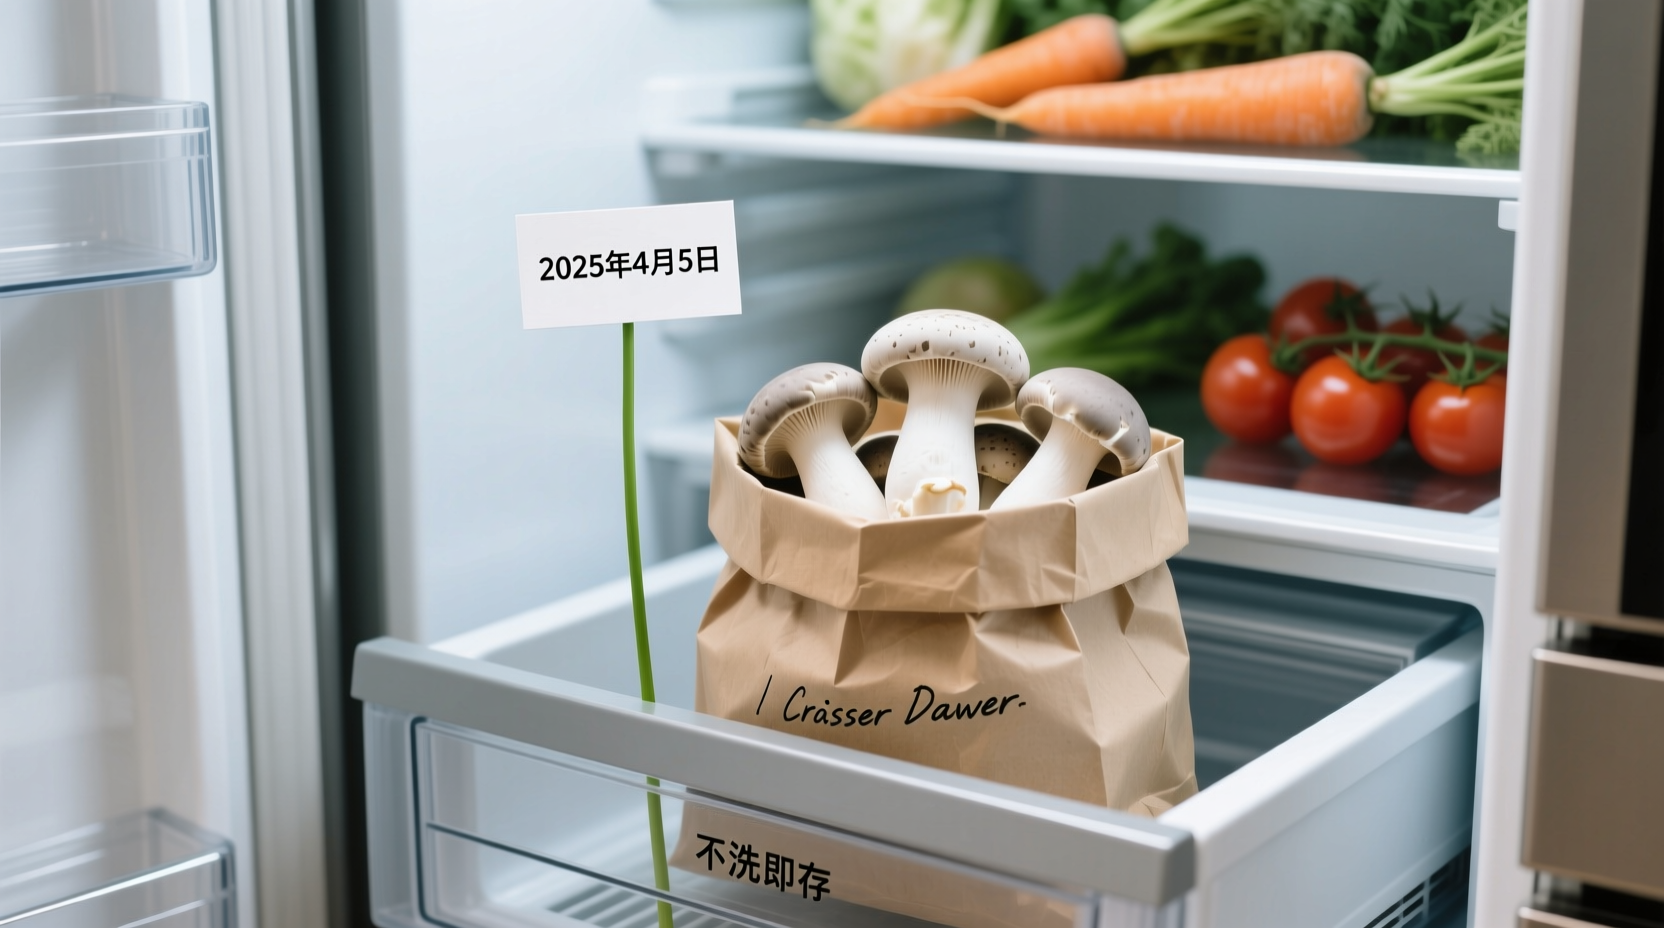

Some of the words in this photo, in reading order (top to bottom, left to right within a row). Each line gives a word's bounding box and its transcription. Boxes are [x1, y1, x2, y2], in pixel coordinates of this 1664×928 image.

[539, 245, 719, 281] 2025年4月5日
[695, 832, 831, 902] 不洗即存
